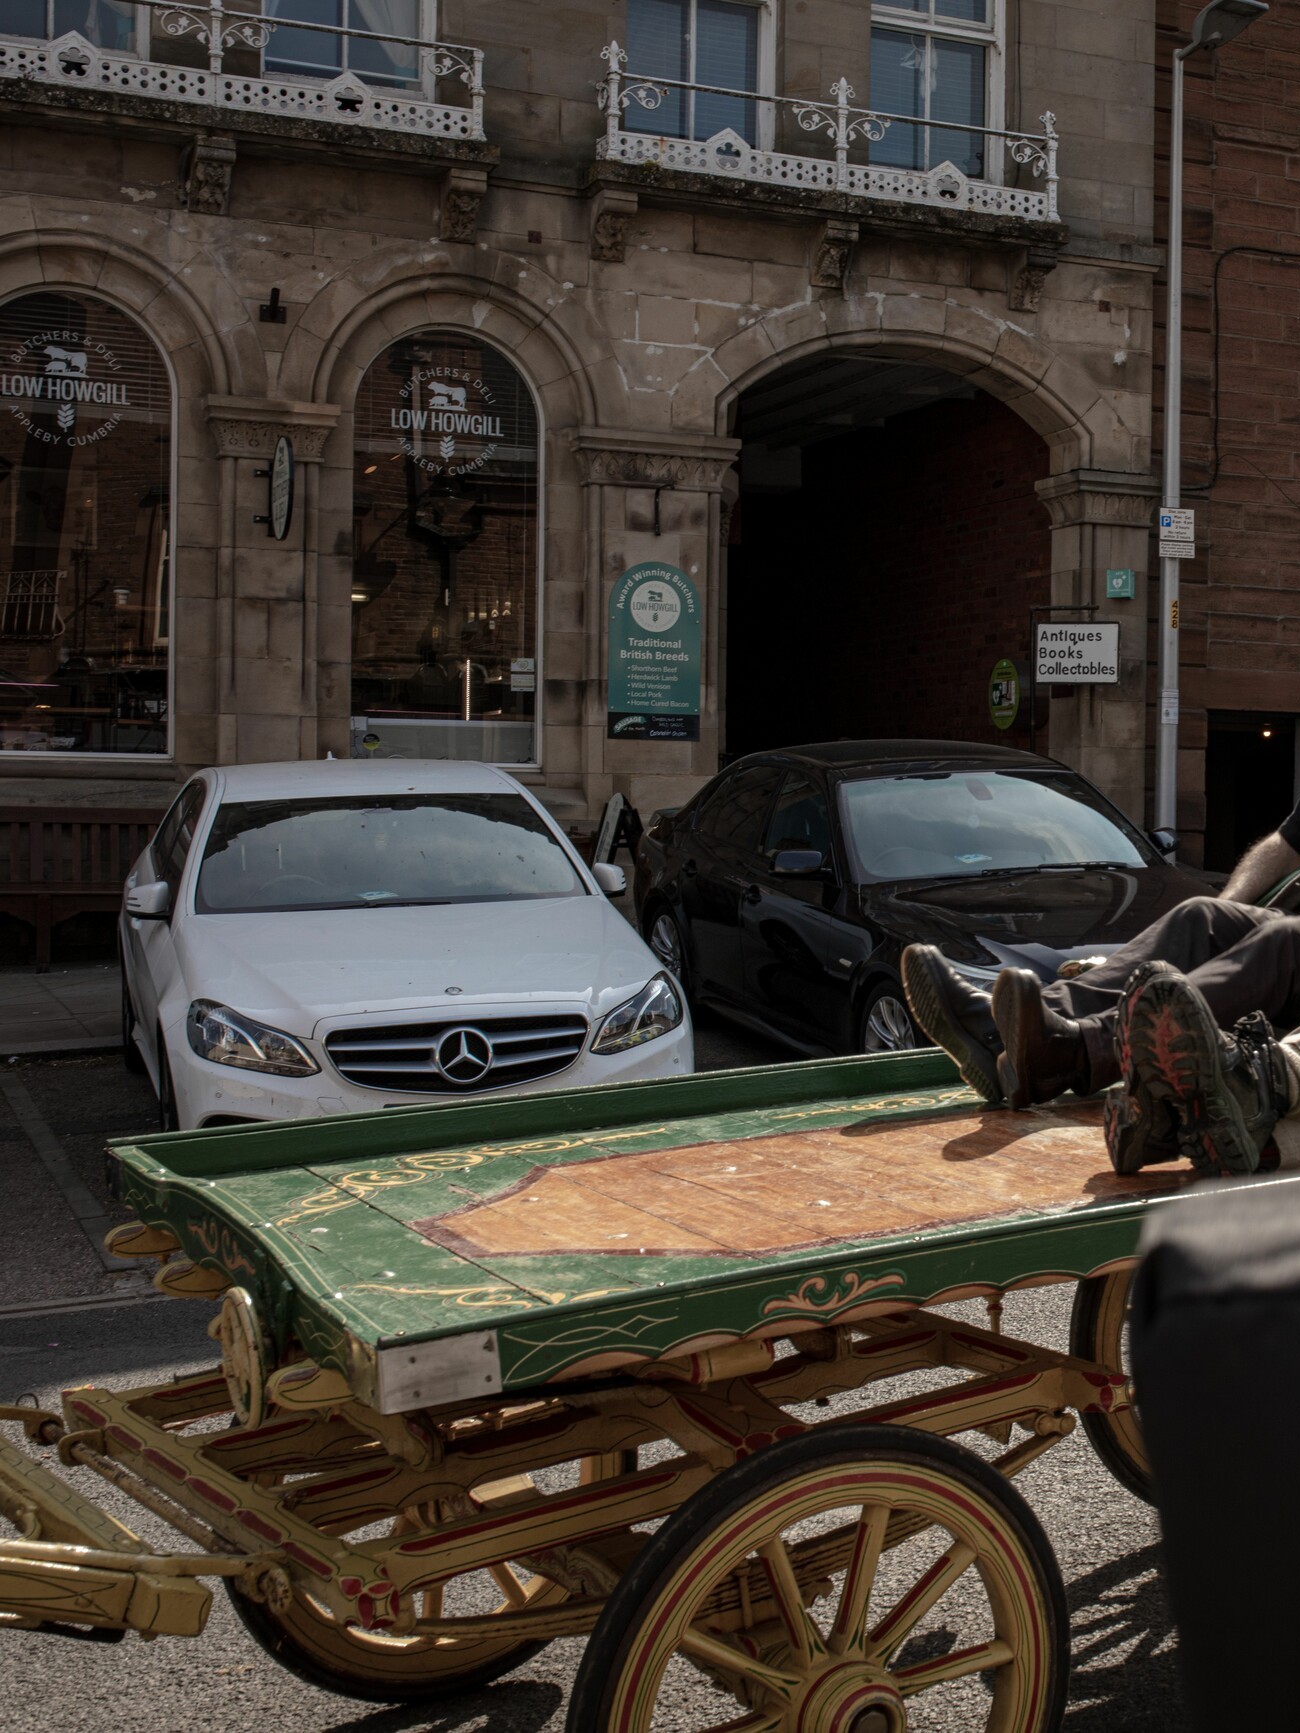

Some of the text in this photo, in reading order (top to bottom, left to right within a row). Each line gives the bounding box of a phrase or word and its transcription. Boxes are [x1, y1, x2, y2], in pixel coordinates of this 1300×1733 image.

[10, 330, 122, 371] BUTCHERS & DELI
[1, 373, 131, 405] LOW HOWGILL
[399, 366, 496, 405] BUTCHERS & DELI
[8, 405, 124, 447] APPLEBY CUMBRIA
[391, 408, 504, 437] LOW HOWGILL
[397, 437, 498, 476] APPLEBY CUMBRIA
[1163, 517, 1170, 526] P
[616, 578, 634, 609] Award
[632, 568, 672, 581] Winning
[672, 574, 695, 614] Butchers
[633, 601, 679, 612] LOW HOWGILL
[628, 637, 682, 649] Traditional
[1040, 629, 1102, 646] Antiques
[620, 649, 689, 662] British Breeds
[1039, 645, 1083, 659] Books
[631, 664, 662, 672] Shorthorn
[1038, 661, 1116, 675] Collectables
[631, 673, 660, 681] Herdwick
[670, 700, 690, 708] Bacon
[614, 716, 642, 731] SAUSAGE
